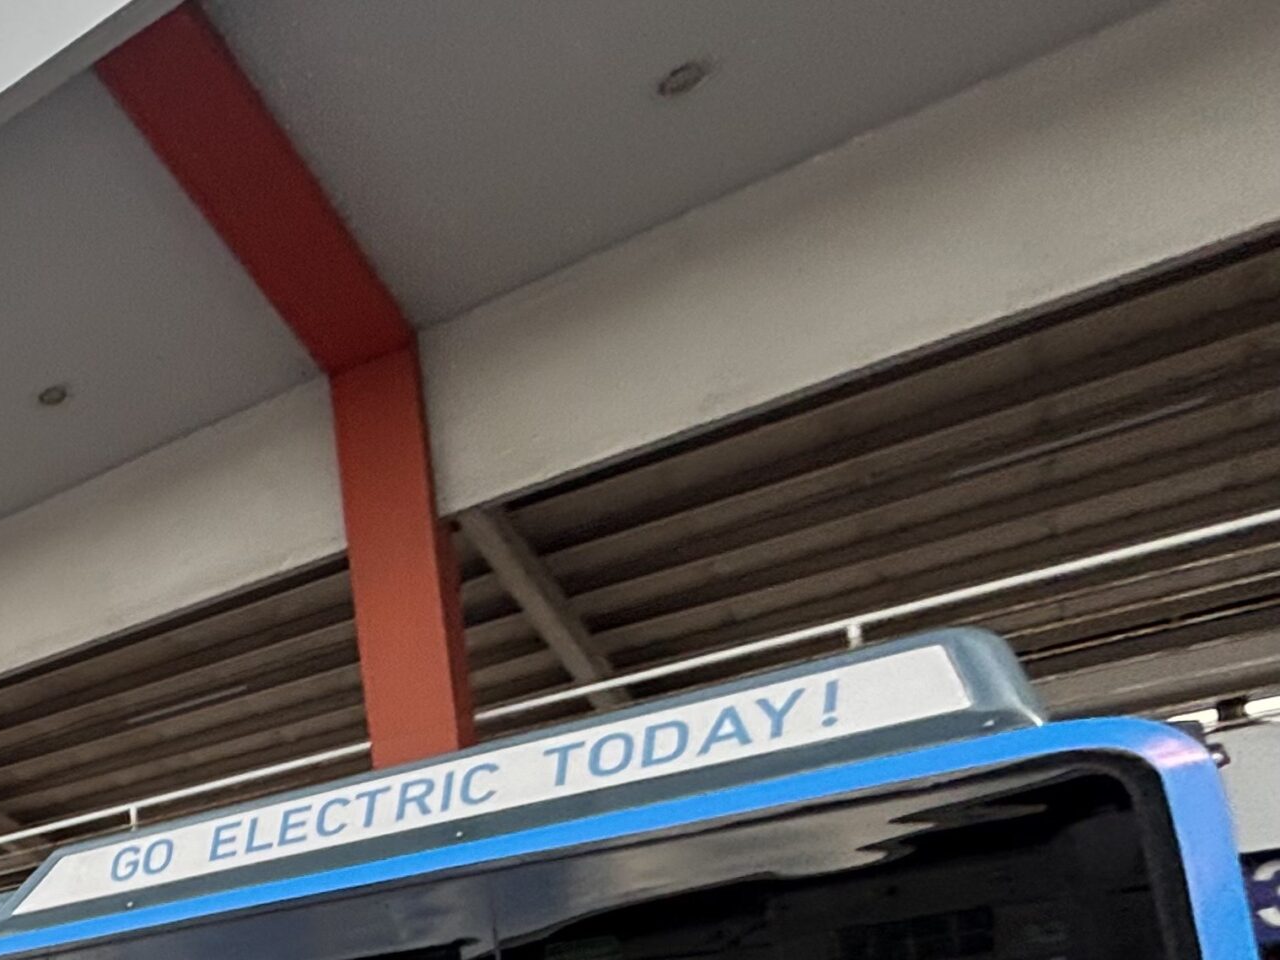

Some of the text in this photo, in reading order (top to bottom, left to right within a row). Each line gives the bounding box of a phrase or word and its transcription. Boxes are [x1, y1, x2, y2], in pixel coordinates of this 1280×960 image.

[111, 680, 841, 883] GO ELECTRIC TODAY!
